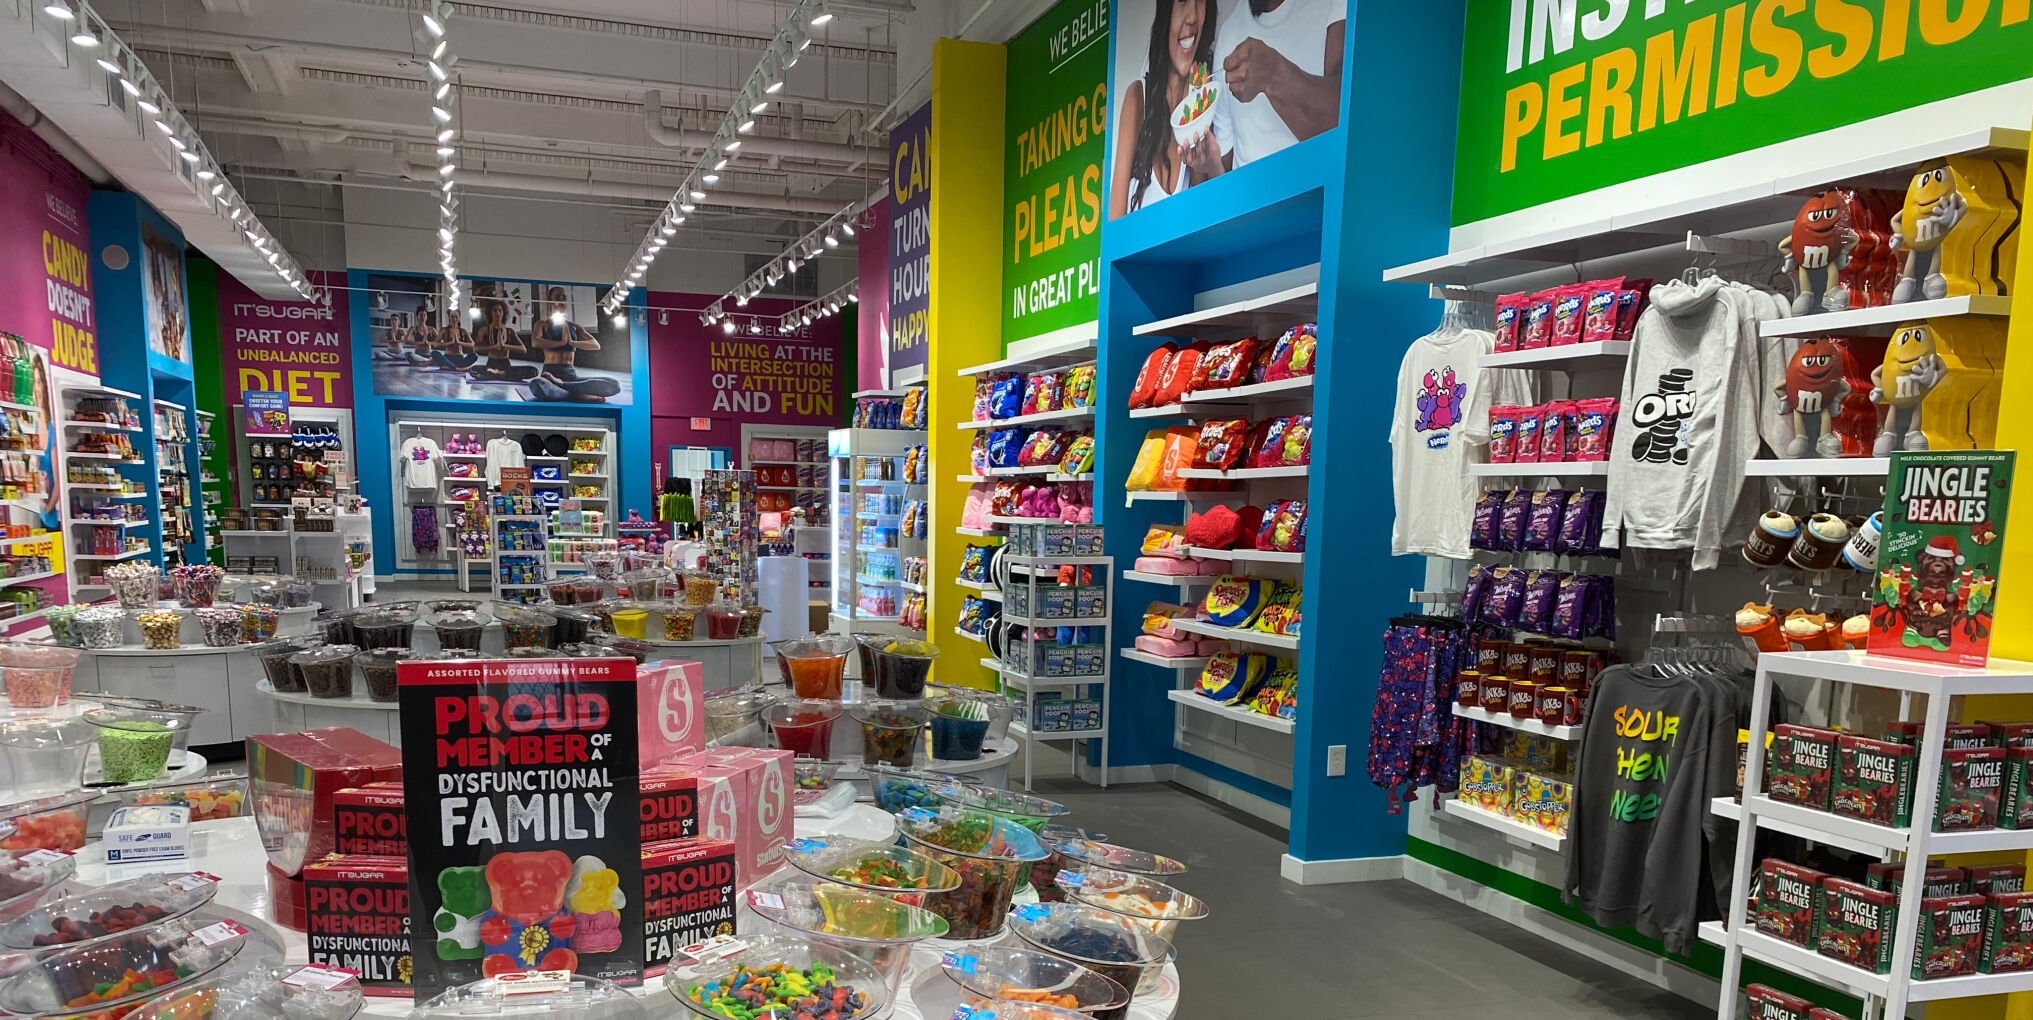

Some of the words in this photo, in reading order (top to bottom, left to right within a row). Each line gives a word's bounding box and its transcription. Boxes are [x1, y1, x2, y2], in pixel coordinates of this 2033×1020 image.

[1050, 25, 1068, 63] WE
[1072, 0, 1106, 47] BELIE
[1506, 0, 1695, 74] INS
[1017, 95, 1087, 178] TAKING
[1014, 163, 1100, 265] PLEAS
[42, 230, 88, 292] CANDY
[1803, 245, 1829, 268] m
[1013, 284, 1026, 318] IN
[1029, 266, 1074, 313] GREAT
[1077, 257, 1100, 299] PL
[46, 278, 91, 327] DOESN'T
[235, 327, 282, 344] PART
[286, 331, 310, 345] OF
[314, 332, 339, 346] AN
[893, 308, 929, 352] HAPPY
[52, 318, 96, 373] JUDGE
[237, 348, 340, 364] UNBALANCED
[710, 341, 770, 359] LIVING
[774, 345, 796, 360] AT
[797, 347, 833, 362] THE
[711, 358, 833, 377] INTERSECTION
[238, 368, 341, 404] DIET
[712, 373, 737, 389] OF
[741, 376, 833, 394] ATTITUDE
[712, 390, 771, 412] AND
[781, 393, 833, 415] FUN
[1798, 390, 1822, 413] m
[1900, 467, 1990, 502] JINGLE
[1907, 499, 1986, 523] BEARIES
[427, 669, 480, 677] ASSORTED
[484, 668, 535, 676] FLAVORED
[579, 667, 610, 675] BEARS
[434, 693, 611, 735] PROUD
[1614, 704, 1680, 747] SOUR
[436, 734, 589, 768] MEMBER
[590, 733, 612, 746] OF
[591, 748, 603, 760] A
[1792, 740, 1828, 758] JINGLE
[1953, 738, 1986, 749] JINGLE
[1795, 754, 1828, 769] BEARIES
[1857, 753, 1895, 772] JINGLE
[1967, 762, 2002, 779] JINGLE
[438, 767, 613, 795] DYSFUNCTIONAL
[1860, 767, 1895, 784] BEARIES
[1969, 777, 2000, 788] BEARIES
[440, 792, 613, 847] FAMILY
[682, 818, 694, 827] OF
[119, 834, 133, 842] SAFE
[152, 832, 172, 840] GUARD
[644, 862, 731, 898] PROUD
[1777, 878, 1811, 899] JINGLE
[1928, 883, 1960, 898] JINGLE
[1993, 878, 2023, 893] JINGLE
[309, 887, 410, 913] PROUD
[644, 888, 721, 918] MEMBER
[722, 886, 732, 894] OF
[1780, 892, 1809, 909] BEARIES
[1841, 897, 1879, 919] JINGLE
[312, 914, 401, 935] MEMBER
[645, 906, 733, 935] DYSFUNCTIONAL
[1844, 912, 1878, 930] BEARIES
[1949, 908, 1982, 927] JINGLE
[1951, 923, 1980, 936] BEARIES
[312, 936, 410, 952] DYSFUNCTIONA
[1763, 1003, 1797, 1020] JINGLE
